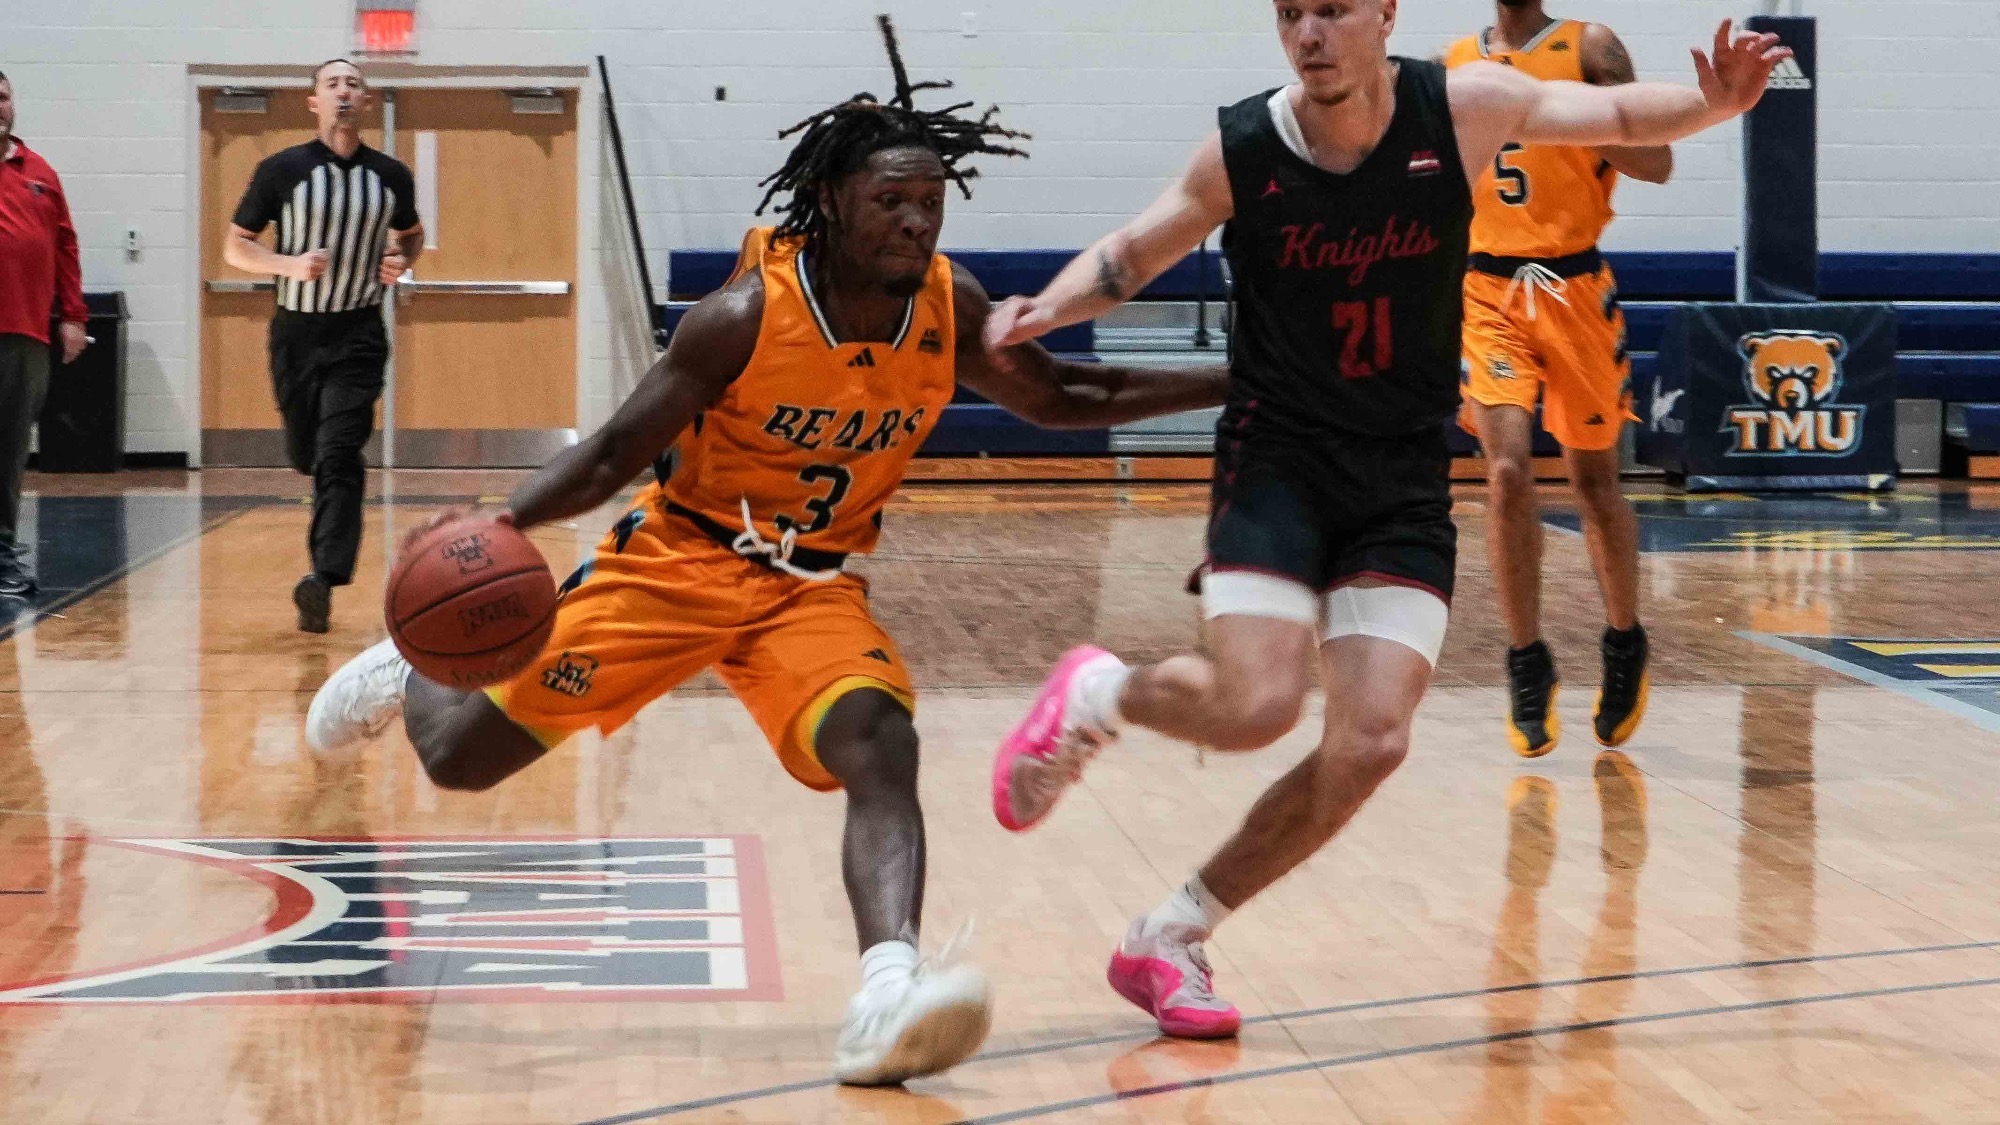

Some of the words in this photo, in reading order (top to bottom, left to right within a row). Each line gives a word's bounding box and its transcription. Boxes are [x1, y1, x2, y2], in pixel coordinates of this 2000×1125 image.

[1494, 141, 1532, 207] 5
[1277, 213, 1441, 288] Knights
[1331, 297, 1393, 380] 21
[762, 404, 926, 452] BEARS
[1730, 410, 1858, 452] TMU
[774, 463, 853, 533] 3
